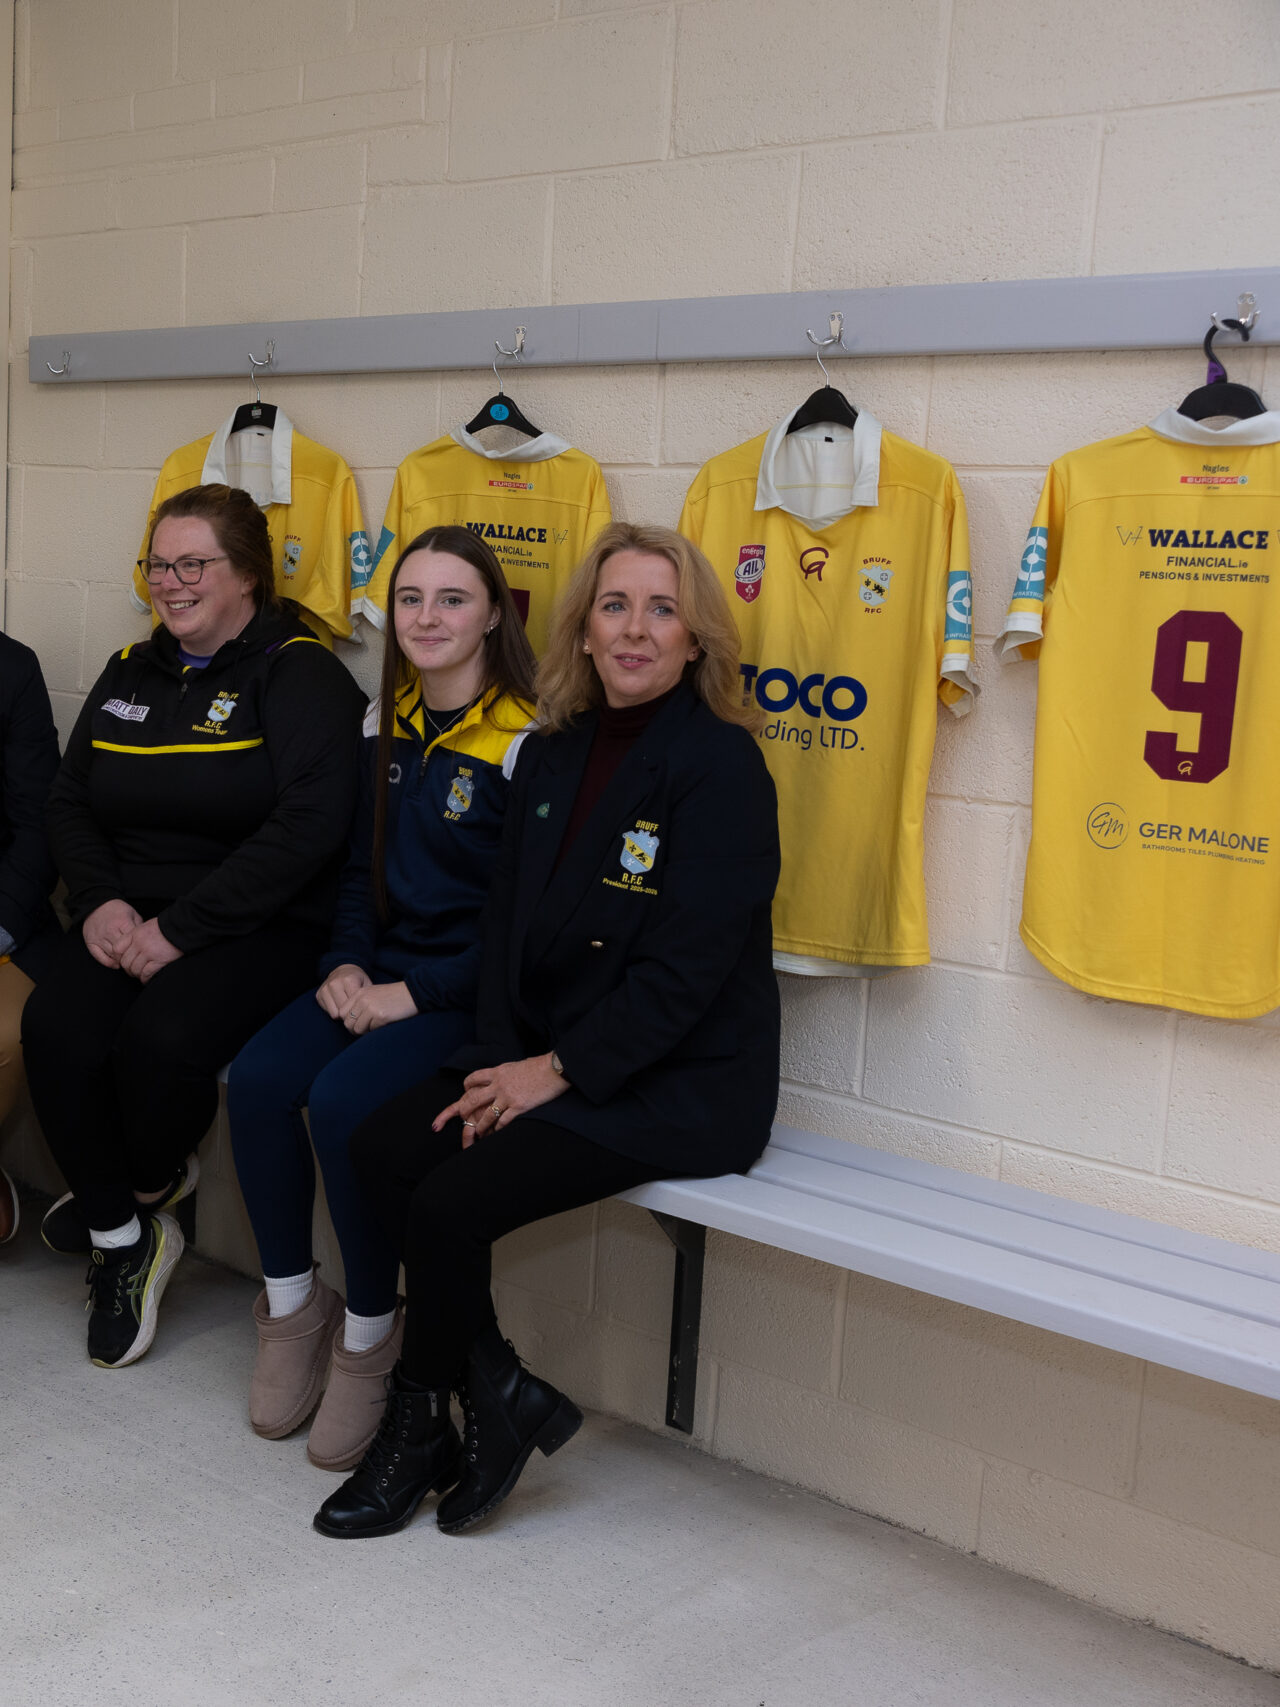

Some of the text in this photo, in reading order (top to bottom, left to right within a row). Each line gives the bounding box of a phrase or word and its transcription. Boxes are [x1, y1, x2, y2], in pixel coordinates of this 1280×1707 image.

[1202, 464, 1230, 474] Nagles
[1148, 529, 1270, 550] WALLACE
[488, 544, 533, 557] NANCIAL.ie
[862, 556, 892, 565] BRUFF
[1166, 555, 1249, 569] FINANCIAL.ie
[743, 560, 759, 576] AIL
[1139, 571, 1270, 583] PENSIONS & INVESTMENTS
[218, 691, 239, 700] BRFF
[1143, 610, 1244, 784] 9
[820, 726, 865, 751] LTD.
[635, 819, 660, 832] BRUFF
[1138, 822, 1270, 854] GER MALONE
[1141, 843, 1186, 853] BATHROOMS
[1188, 848, 1206, 856] TILES
